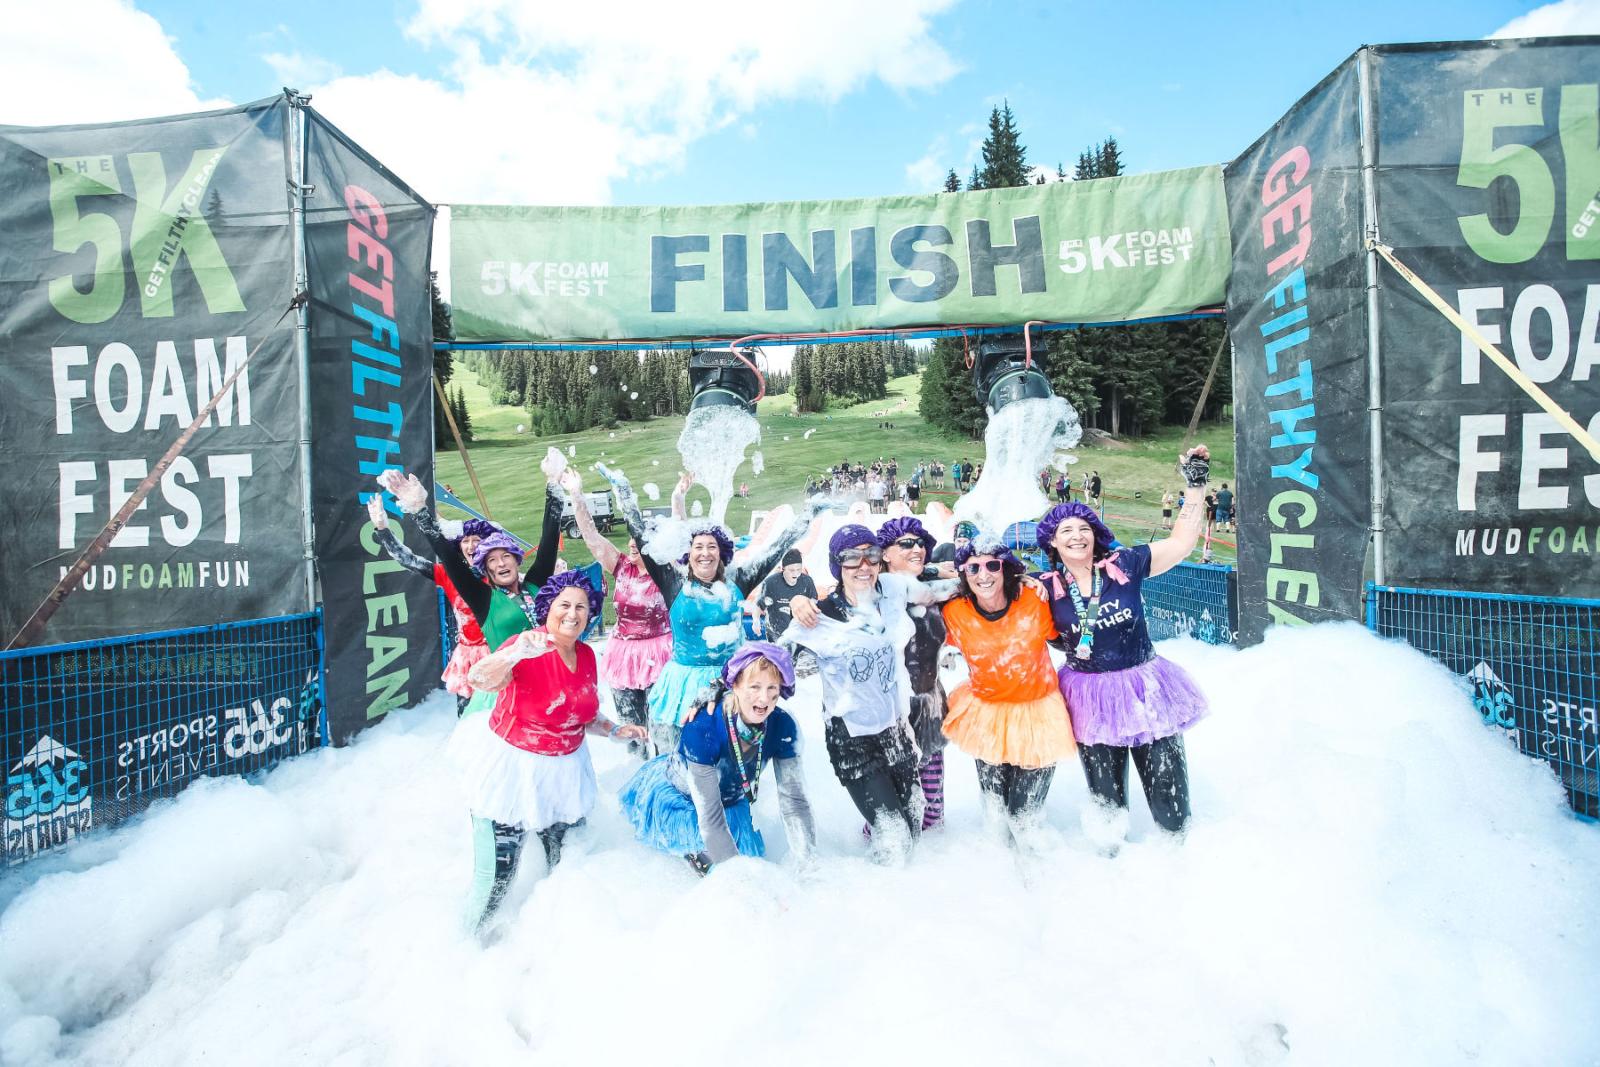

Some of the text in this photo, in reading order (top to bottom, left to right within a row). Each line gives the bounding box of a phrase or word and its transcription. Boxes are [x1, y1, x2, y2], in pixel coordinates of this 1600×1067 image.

[1471, 92, 1537, 106] THE
[54, 159, 111, 175] THE
[48, 145, 247, 324] 5K
[1125, 226, 1193, 249] FOAM
[650, 214, 1047, 313] FINISH
[1058, 233, 1128, 274] 5K
[1127, 244, 1193, 267] FEST
[480, 260, 544, 296] 5K
[543, 261, 609, 278] FOAM
[543, 279, 609, 297] FEST
[51, 335, 251, 435] FOAM
[58, 453, 253, 549] FEST
[1455, 526, 1600, 556] MUDFOA
[1071, 608, 1133, 634] MTHER
